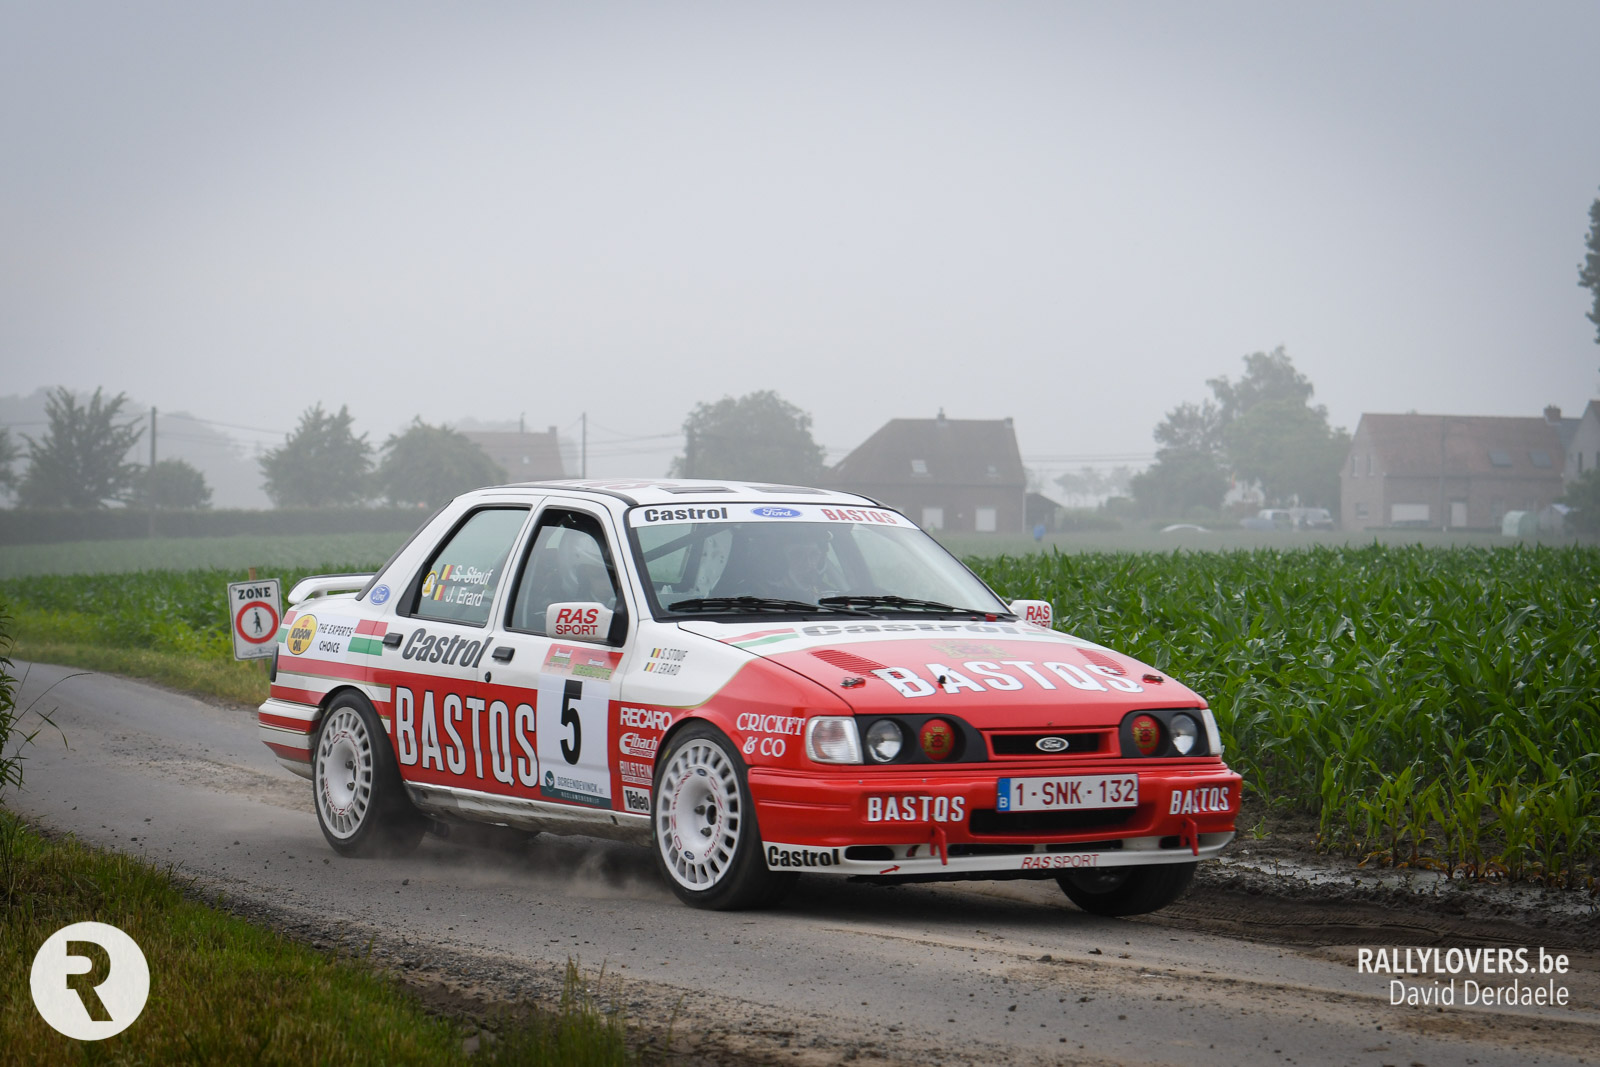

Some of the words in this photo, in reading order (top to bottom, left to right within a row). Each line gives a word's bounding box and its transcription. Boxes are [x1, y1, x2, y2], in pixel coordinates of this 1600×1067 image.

[644, 507, 728, 522] Castrol
[238, 587, 271, 600] ZONE
[445, 586, 455, 603] J.
[456, 587, 485, 607] Erard
[556, 608, 599, 624] RAS
[1025, 604, 1050, 621] RAS
[555, 624, 598, 636] SPORT
[319, 640, 340, 653] CHOICE
[402, 628, 494, 668] Castrol
[560, 679, 583, 765] 5
[620, 706, 673, 732] RECARO
[736, 712, 806, 736] CRICKET
[619, 732, 658, 756] Eibach
[743, 737, 759, 755] &
[760, 738, 786, 758] CO
[620, 760, 653, 779] BILSTEIN
[625, 789, 650, 812] Valeo
[999, 797, 1009, 808] B
[768, 845, 841, 867] Castrol
[1021, 857, 1051, 870] RAS
[1053, 853, 1099, 869] SPORT
